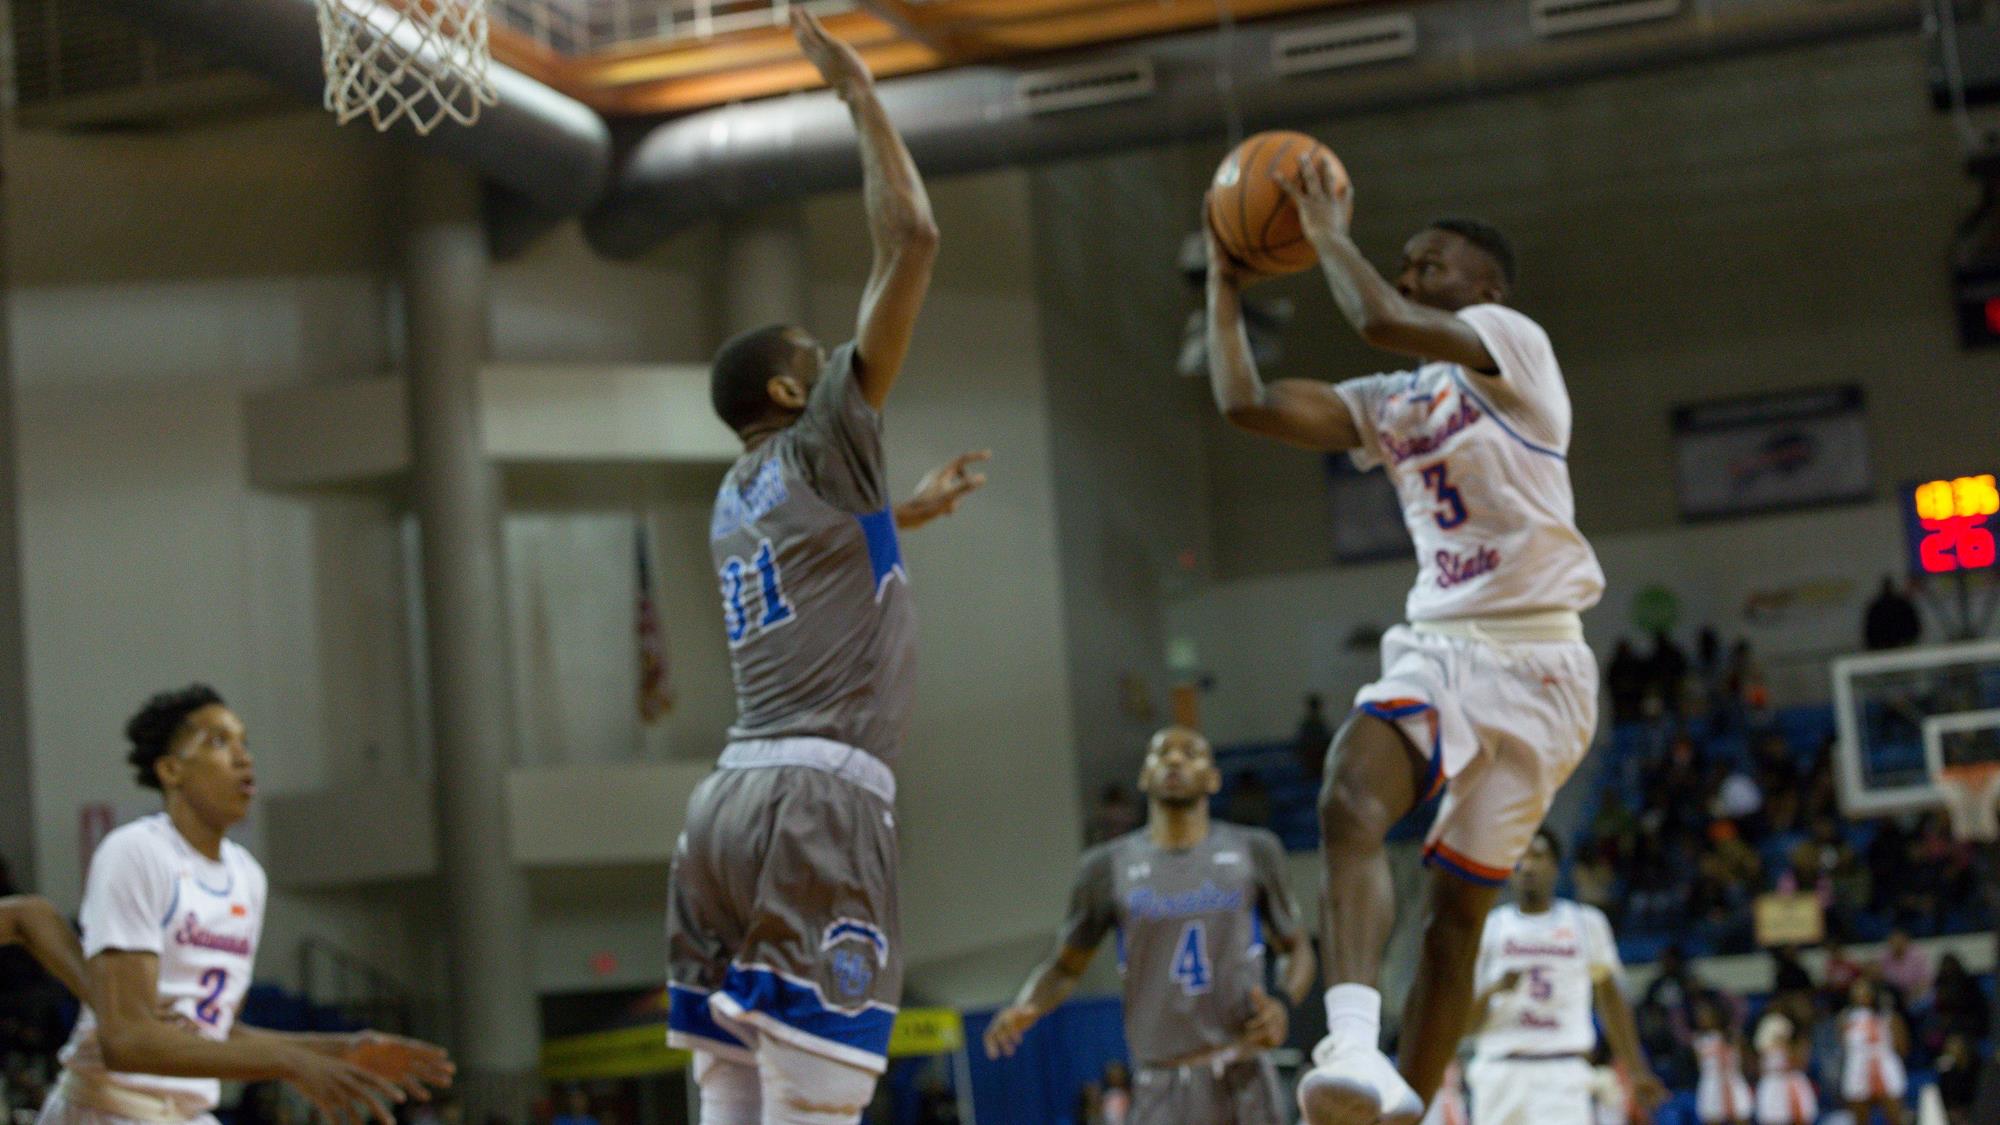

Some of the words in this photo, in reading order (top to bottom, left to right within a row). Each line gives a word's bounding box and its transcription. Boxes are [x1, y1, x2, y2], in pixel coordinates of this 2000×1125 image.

[1419, 459, 1469, 532] 3
[1435, 545, 1501, 589] State
[1919, 516, 1996, 573] 26
[1169, 919, 1214, 996] 4
[1528, 965, 1553, 1001] 5
[196, 966, 228, 1026] 2
